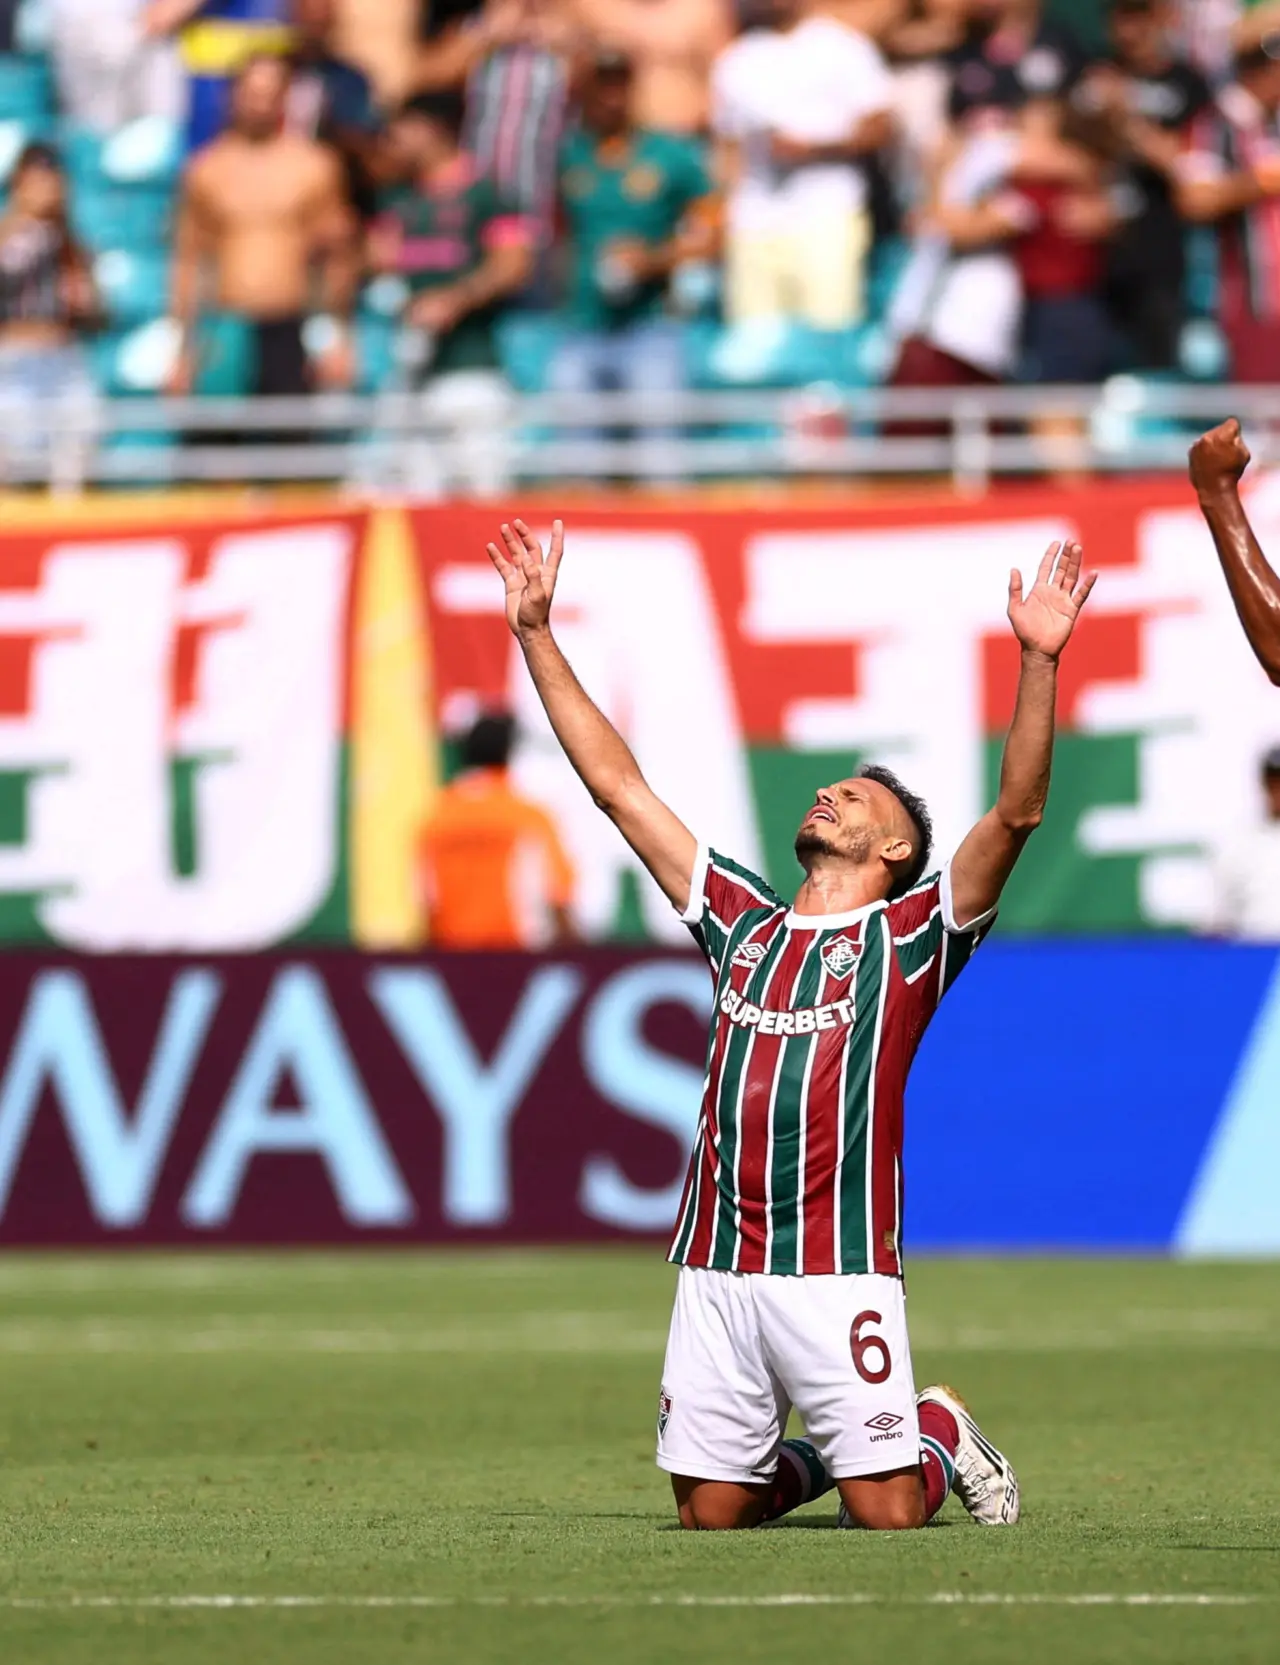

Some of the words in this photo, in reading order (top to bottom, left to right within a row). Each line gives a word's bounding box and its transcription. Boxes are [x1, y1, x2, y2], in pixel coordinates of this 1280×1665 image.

[719, 988, 855, 1036] SUPERBET
[0, 960, 712, 1233] WAYS
[849, 1309, 892, 1385] 6
[869, 1431, 903, 1443] umbro
